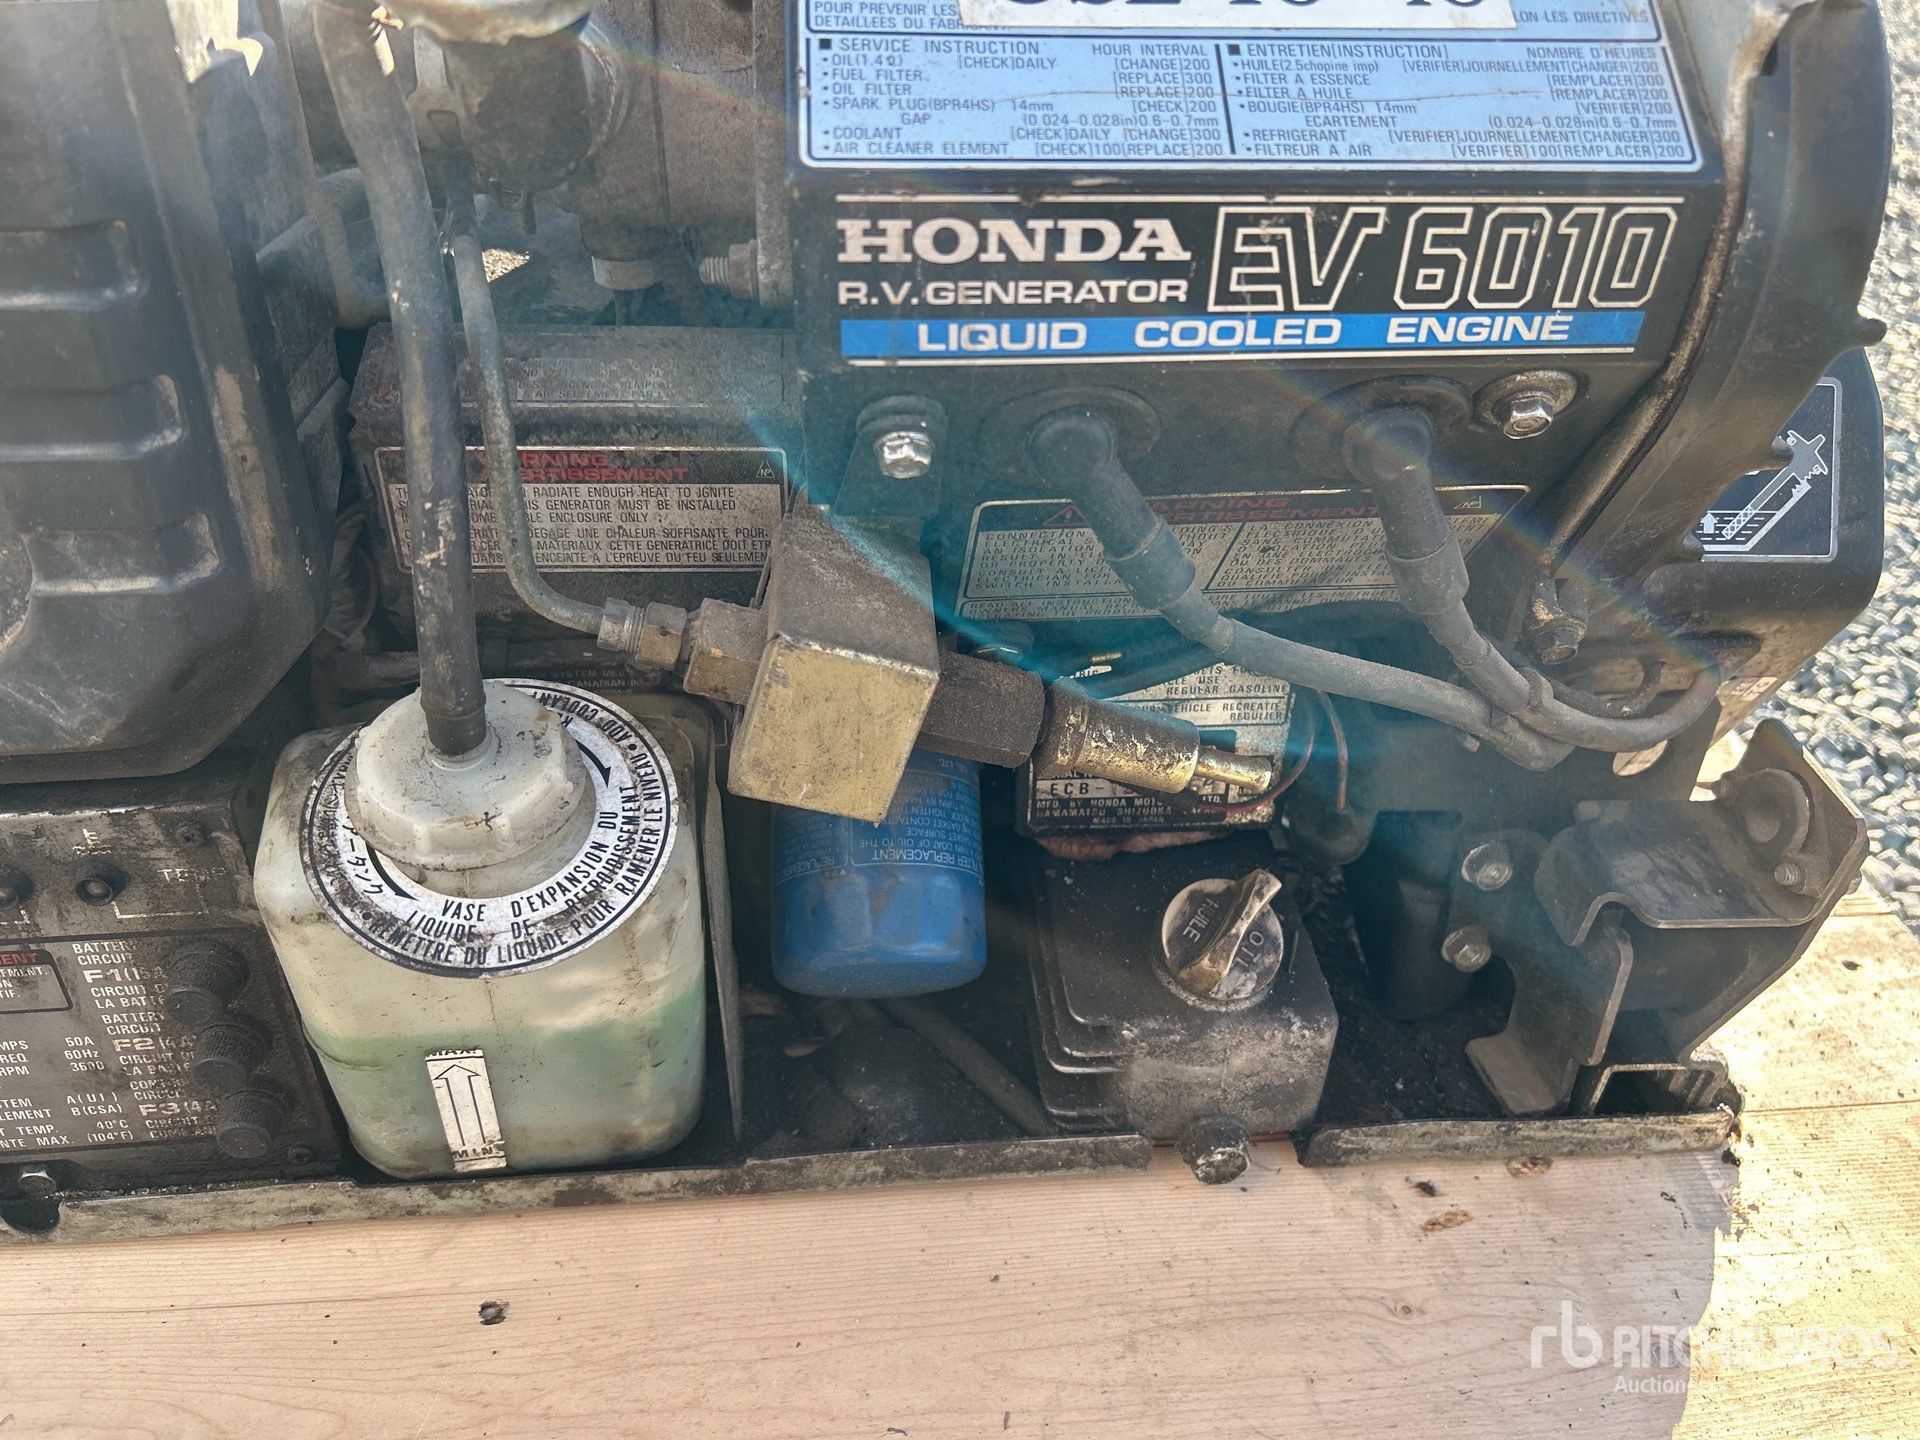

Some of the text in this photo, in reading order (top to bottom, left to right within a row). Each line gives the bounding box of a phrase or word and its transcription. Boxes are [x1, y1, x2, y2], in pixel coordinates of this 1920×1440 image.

[814, 3, 957, 17] POUR PREVENIR LES
[814, 15, 897, 29] DETAILLEES
[904, 17, 924, 30] DU
[1544, 11, 1569, 23] LES
[840, 38, 1040, 55] SERVICE INSTRUCTION
[1092, 43, 1208, 57] HOUR INTERVAL
[1246, 44, 1657, 60] ENTRETIEN[INSTRUCTION] NOMBRE D'HEURES
[958, 56, 1057, 70] [CHECK]DAILY
[1115, 58, 1211, 72] [CHANGE]200
[1353, 60, 1379, 73] imp)
[831, 69, 923, 82] FUEL FILTER
[1113, 71, 1213, 86] [REPLACE]300
[1243, 73, 1288, 85] FILTER
[1294, 74, 1305, 85] A
[1310, 74, 1371, 86] ESSENCE
[831, 83, 912, 96] OIL FILTER
[1115, 86, 1215, 100] [REPLACE]200
[1245, 87, 1290, 99] FILTER
[1297, 87, 1307, 99] A
[1313, 87, 1354, 100] HUILE
[831, 97, 1054, 113] SPARK PLUG(BPR4HS) 14mm
[1133, 100, 1217, 114] [CHECK]200
[1248, 101, 1365, 114] BOUGIE(BPR4HS)
[1375, 102, 1417, 114] 14mm
[901, 113, 932, 126] GAP
[1304, 115, 1397, 128] ECARTEMENT
[832, 127, 904, 141] COOLANT
[1252, 129, 1347, 142] REFRIGERANT
[833, 142, 859, 155] AIR
[868, 142, 933, 156] CLEANER
[942, 142, 1010, 156] ELEMENT
[1254, 144, 1319, 156] FILTREUR
[1329, 145, 1340, 156] A
[1348, 144, 1373, 157] AIR
[835, 218, 1192, 265] HONDA
[1207, 205, 1678, 313] EV 6010
[917, 313, 1575, 353] LIQUID COOLED ENGINE
[534, 487, 735, 498] RADIATE ENOUGH HEAT TO IGNITE
[546, 499, 736, 511] GENERATOR MUST BE INSTALLED
[550, 512, 648, 524] ENCLOSURE ONLY
[1284, 520, 1374, 530] CONNEXION
[577, 528, 599, 539] UNE
[606, 528, 656, 539] CHALEUR
[663, 528, 729, 539] SUFFISANTE
[985, 530, 1087, 541] CONNECTION
[537, 540, 601, 551] MATERIAUX
[609, 540, 643, 551] CETTE
[646, 540, 718, 551] GENERATRICE
[983, 544, 1096, 555] AN ISOLATION
[473, 552, 768, 564] DANS ENCEINTE L'EPREUVE DU FEU SEULEMEN
[1009, 558, 1087, 568] PROPERTY
[978, 568, 1044, 577] CONSULT
[975, 582, 1034, 590] SWITCH
[1166, 683, 1289, 697] REGULAR GASOLINE
[600, 718, 634, 745] ADD
[628, 752, 664, 800] NIVEAU
[1090, 797, 1128, 808] HONDA
[643, 806, 663, 823] LE
[1116, 806, 1172, 817] SHIZUOKA
[906, 827, 946, 839] SURFACE
[859, 838, 914, 848] OIL THE
[613, 827, 661, 897] RAMENER
[871, 849, 955, 866] REPLACEMENT
[441, 810, 619, 922] VASE D'EXPANSION DU
[570, 898, 617, 937] POUR
[1182, 896, 1220, 944] HUILE
[404, 909, 477, 943] LIQUIDE
[509, 917, 534, 940] DE
[497, 926, 569, 964] LIQUIDE
[463, 945, 489, 966] DU
[94, 998, 116, 1010] LA
[64, 1035, 96, 1047] 50A
[63, 1048, 101, 1061] 60Hz
[69, 1060, 106, 1073] 3600
[15, 1118, 129, 1137] TEMP. 40°C
[35, 1134, 76, 1147] MAX.
